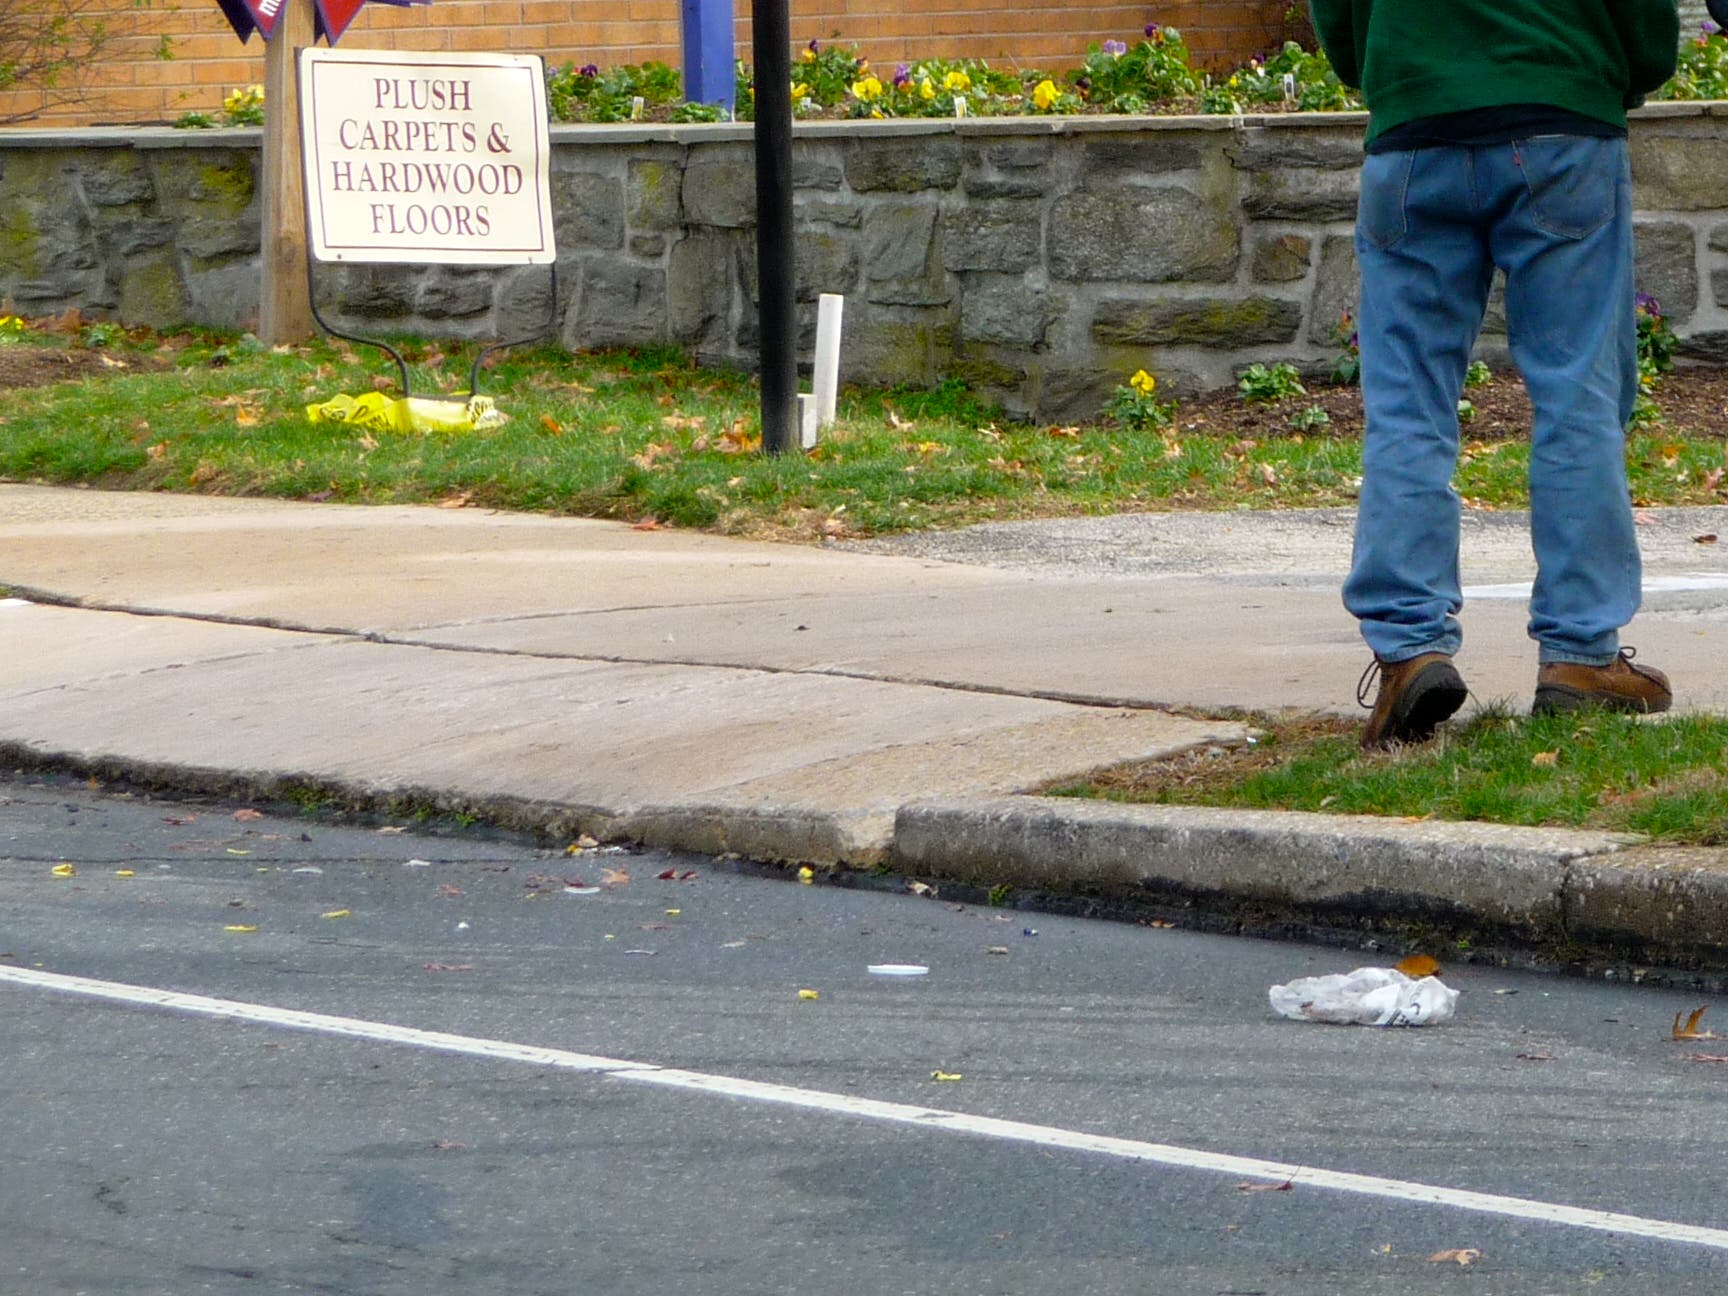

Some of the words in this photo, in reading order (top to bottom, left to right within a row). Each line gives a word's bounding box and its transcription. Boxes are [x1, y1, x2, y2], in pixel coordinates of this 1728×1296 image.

[375, 79, 472, 110] PLUSH
[340, 119, 476, 152] CARPETS
[487, 123, 511, 153] &
[333, 162, 522, 194] HARDWOOD
[371, 204, 489, 236] FLOORS
